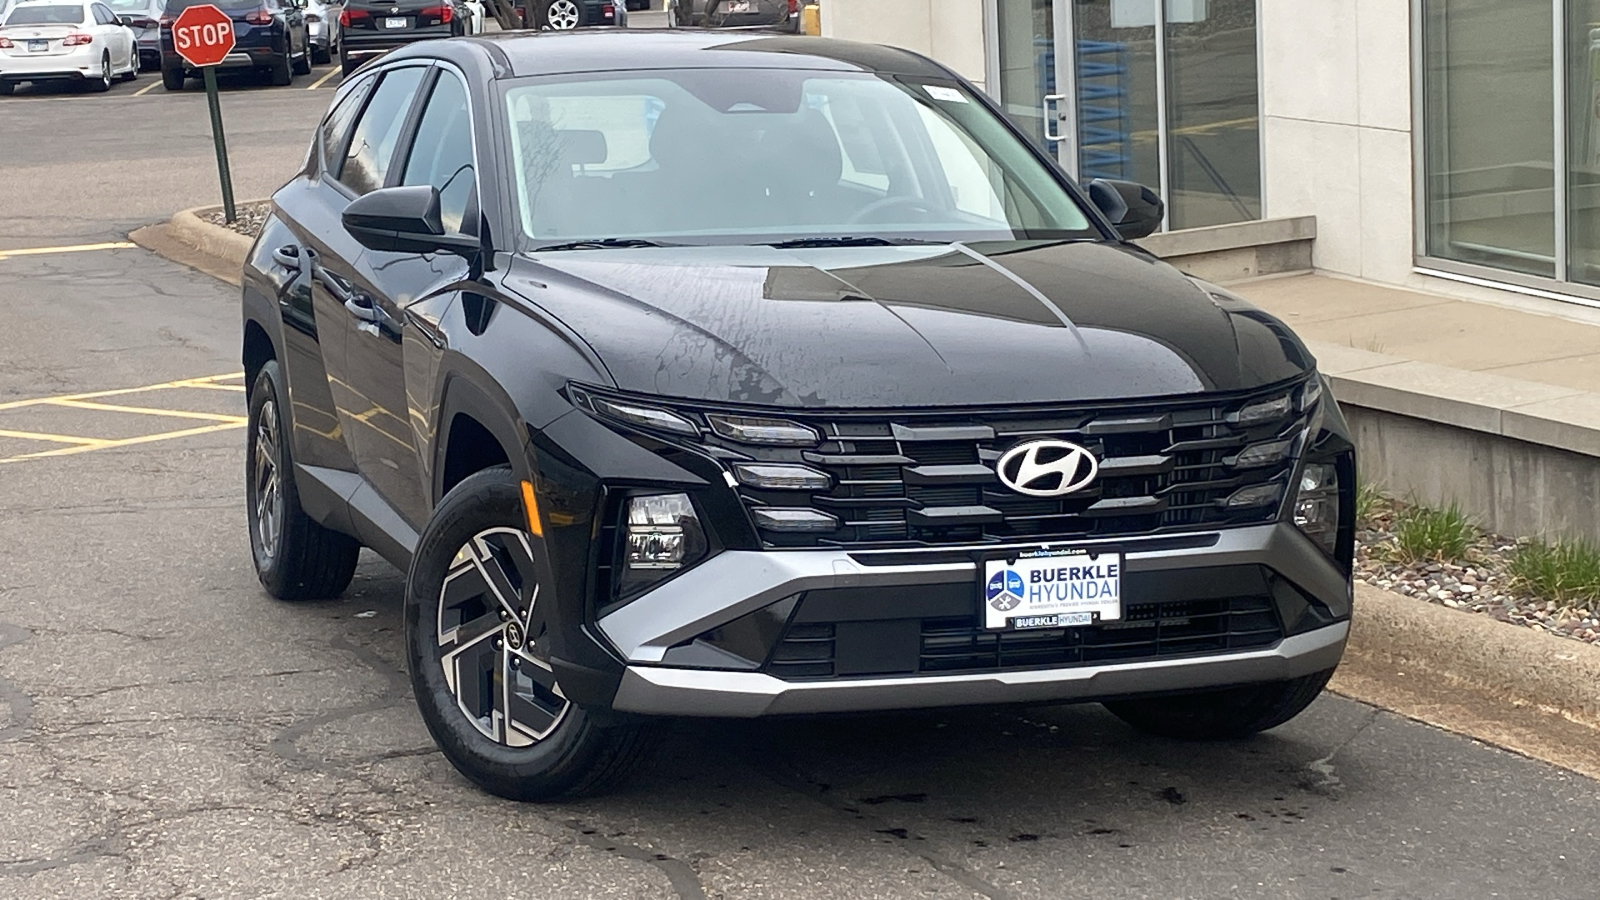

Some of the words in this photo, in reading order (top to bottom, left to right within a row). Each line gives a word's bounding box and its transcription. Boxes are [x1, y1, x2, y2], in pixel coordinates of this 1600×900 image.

[177, 22, 230, 49] STOP
[1030, 564, 1118, 584] BUERKLE
[1029, 579, 1118, 604] HYUNDAI
[1016, 616, 1058, 628] BUERKLE
[1059, 613, 1091, 624] HYUNDAI
